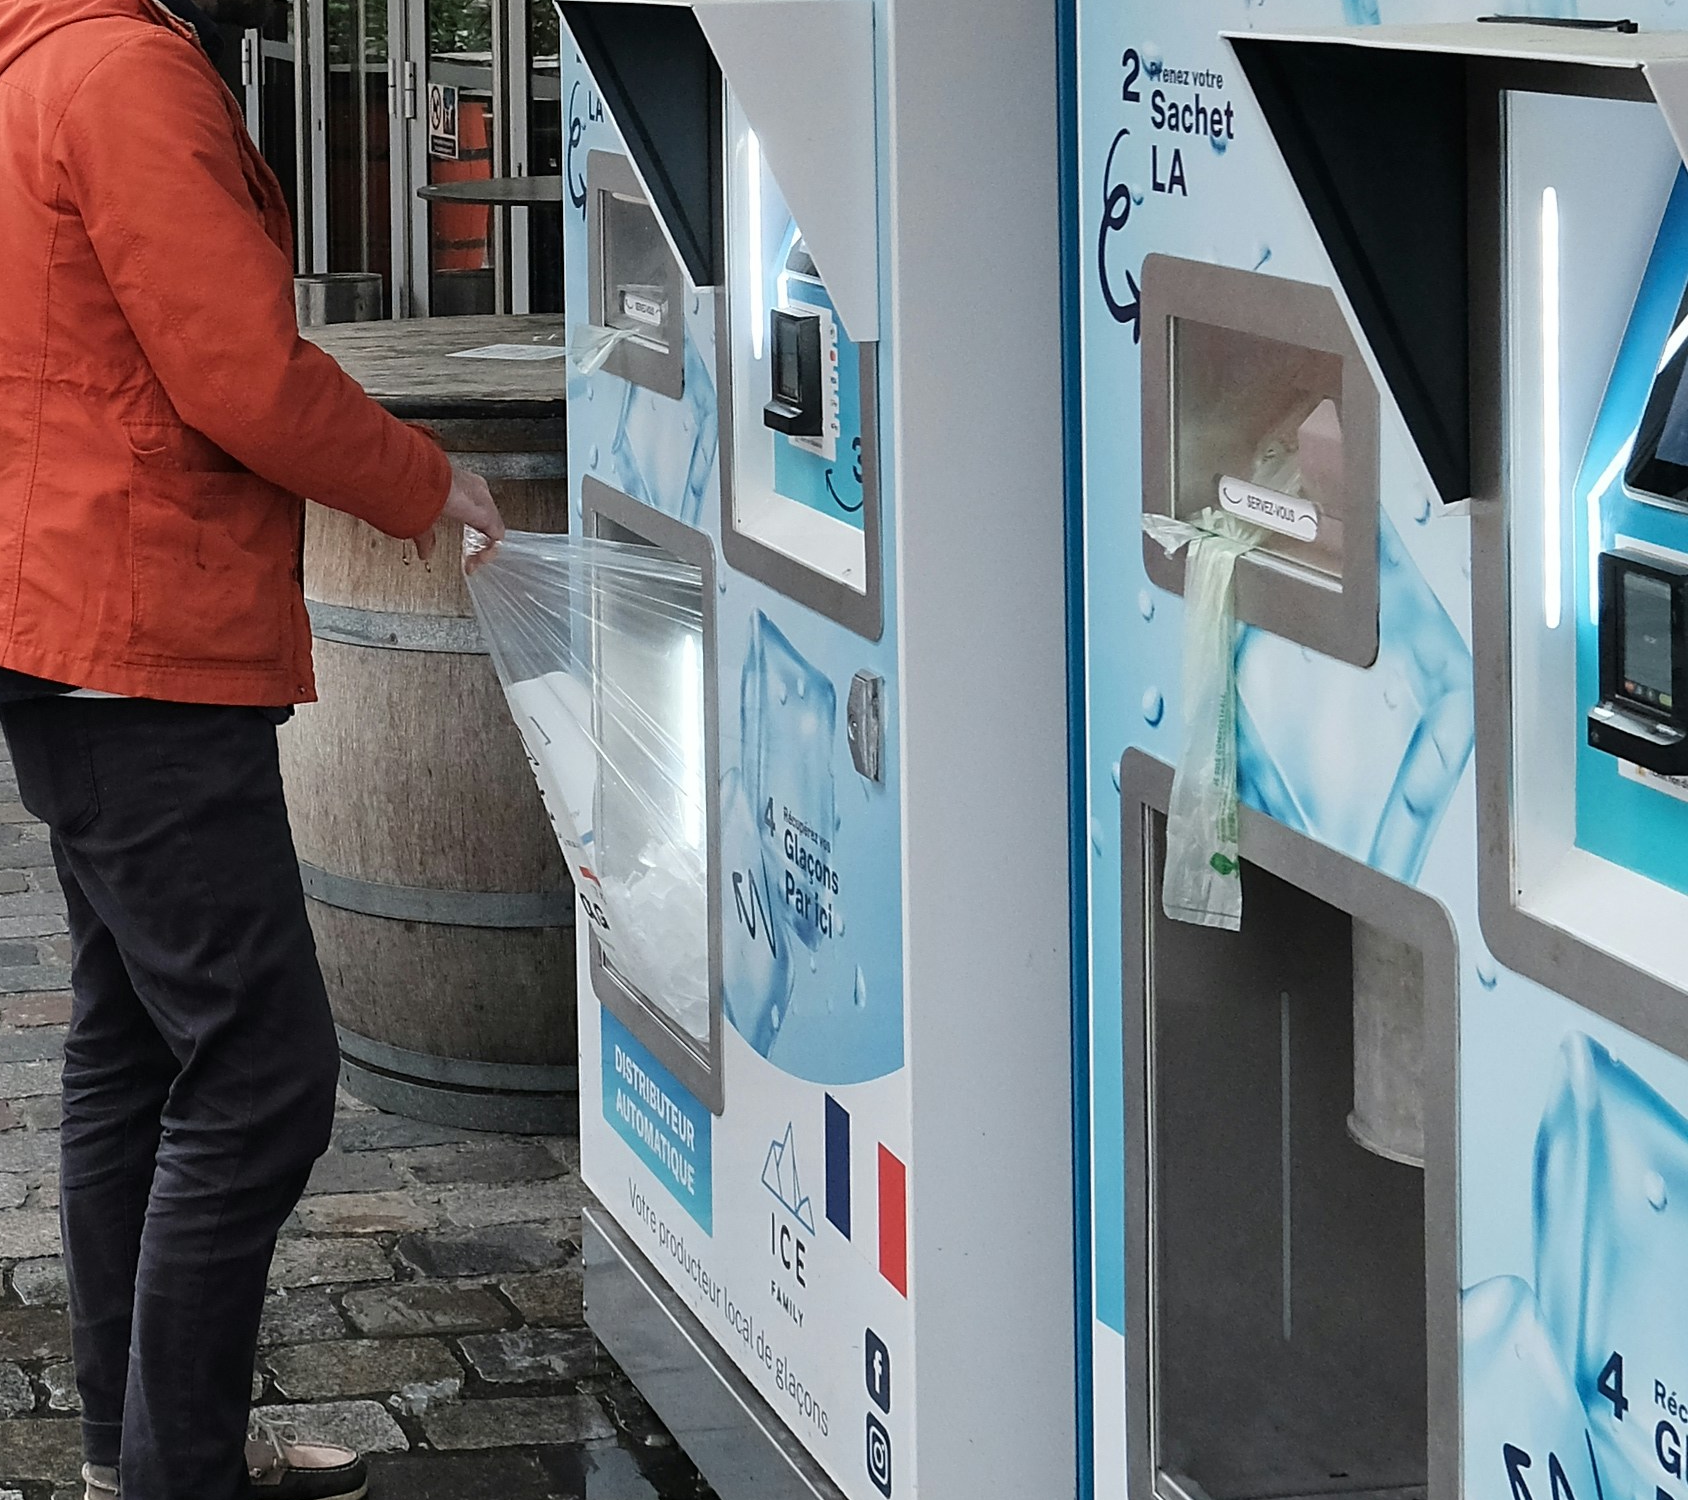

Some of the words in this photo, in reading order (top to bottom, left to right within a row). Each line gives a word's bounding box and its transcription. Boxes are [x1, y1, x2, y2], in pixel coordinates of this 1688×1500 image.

[1122, 48, 1140, 103] 2
[1150, 61, 1190, 86] Prenez
[1192, 68, 1224, 89] votre
[588, 90, 604, 123] LA
[1151, 89, 1234, 140] Sachet
[1152, 145, 1188, 196] LA
[1247, 494, 1295, 523] SERVEZ-VOUS
[764, 797, 776, 837] 4
[784, 829, 839, 894] Glaçons
[785, 869, 811, 920] Par
[814, 892, 833, 938] ici
[615, 1044, 695, 1152] DISTRIBUTEUR
[616, 1088, 695, 1195] AUTOMATIQUE
[772, 1212, 805, 1288] ICE
[629, 1177, 656, 1233] Votre
[659, 1220, 721, 1308] producteur
[724, 1287, 753, 1349] local
[756, 1331, 772, 1369] de
[775, 1357, 828, 1437] glaçons
[771, 1280, 803, 1328] FAMILY
[1597, 1351, 1629, 1422] 4
